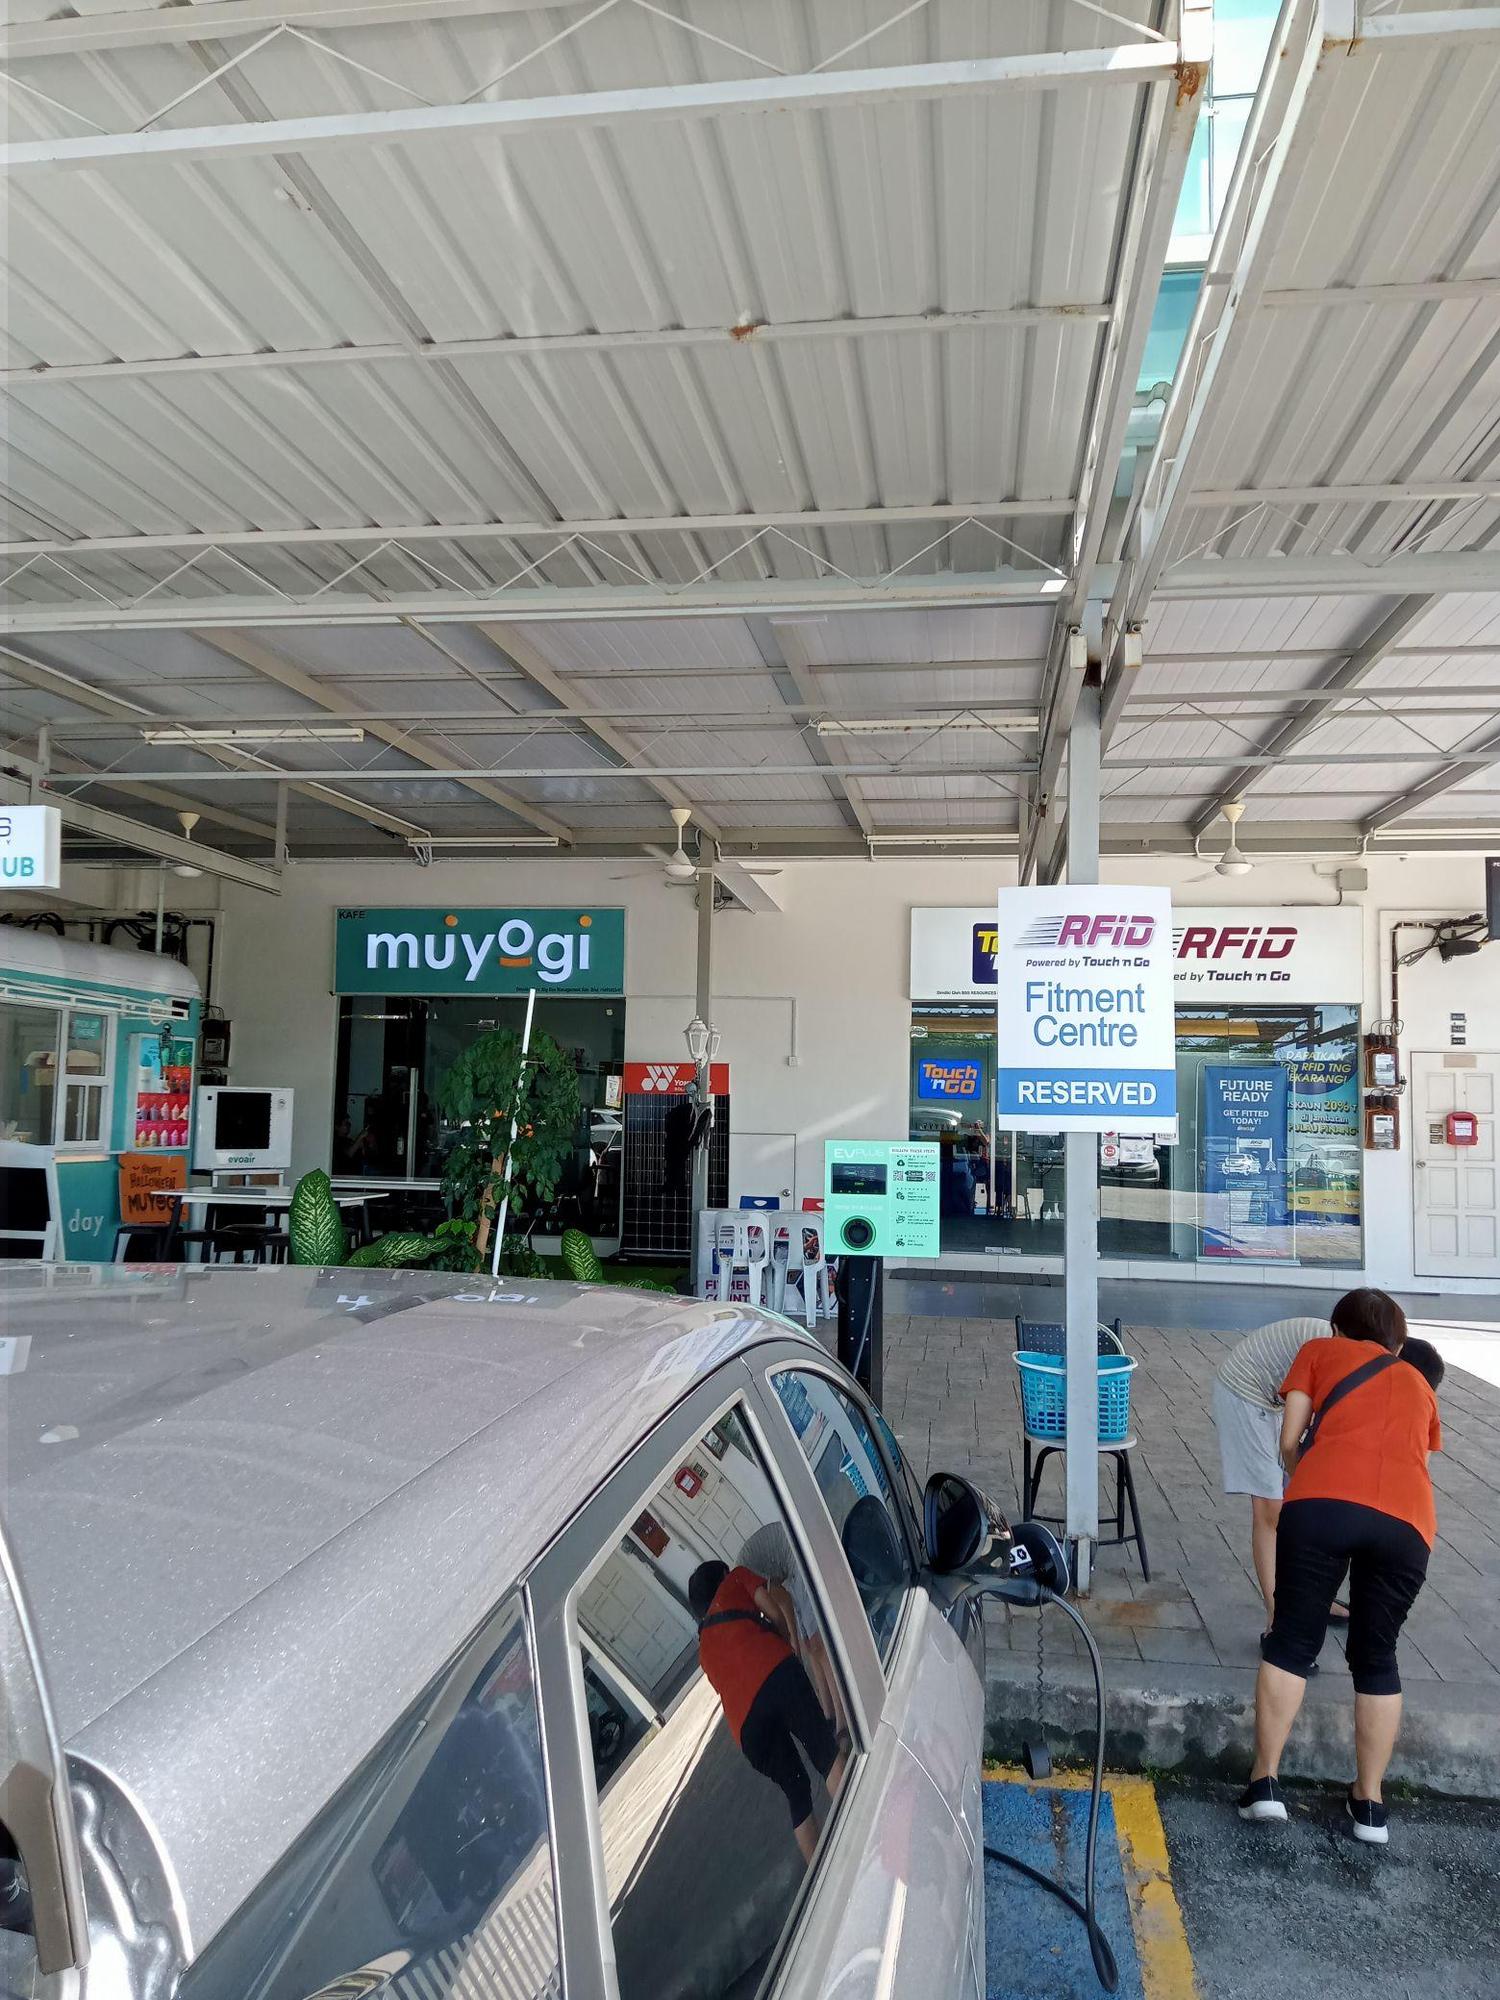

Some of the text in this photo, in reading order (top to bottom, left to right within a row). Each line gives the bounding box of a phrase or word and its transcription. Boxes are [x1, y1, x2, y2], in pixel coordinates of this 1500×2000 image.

[338, 910, 367, 920] KAFE
[366, 914, 593, 984] muyogi
[1026, 957, 1067, 968] Powered
[1068, 957, 1081, 969] by
[1082, 956, 1120, 967] Touch
[1133, 957, 1150, 967] Go
[1189, 972, 1205, 982] by
[1206, 970, 1252, 981] Touch
[1269, 970, 1291, 981] Go
[1025, 981, 1146, 1014] Fitment
[1033, 1015, 1138, 1047] Centre
[922, 1063, 978, 1079] Touch
[1301, 1062, 1325, 1072] RFID
[1328, 1063, 1352, 1073] TNG
[1288, 1073, 1347, 1084] EKARANG!
[1219, 1080, 1273, 1091] FUTURE
[1017, 1080, 1158, 1106] RESERVED
[1223, 1092, 1269, 1102] READY
[1324, 1100, 1350, 1112] 20%
[1231, 1117, 1262, 1125] TODAY!
[228, 1153, 256, 1164] evoair
[69, 1208, 104, 1237] day
